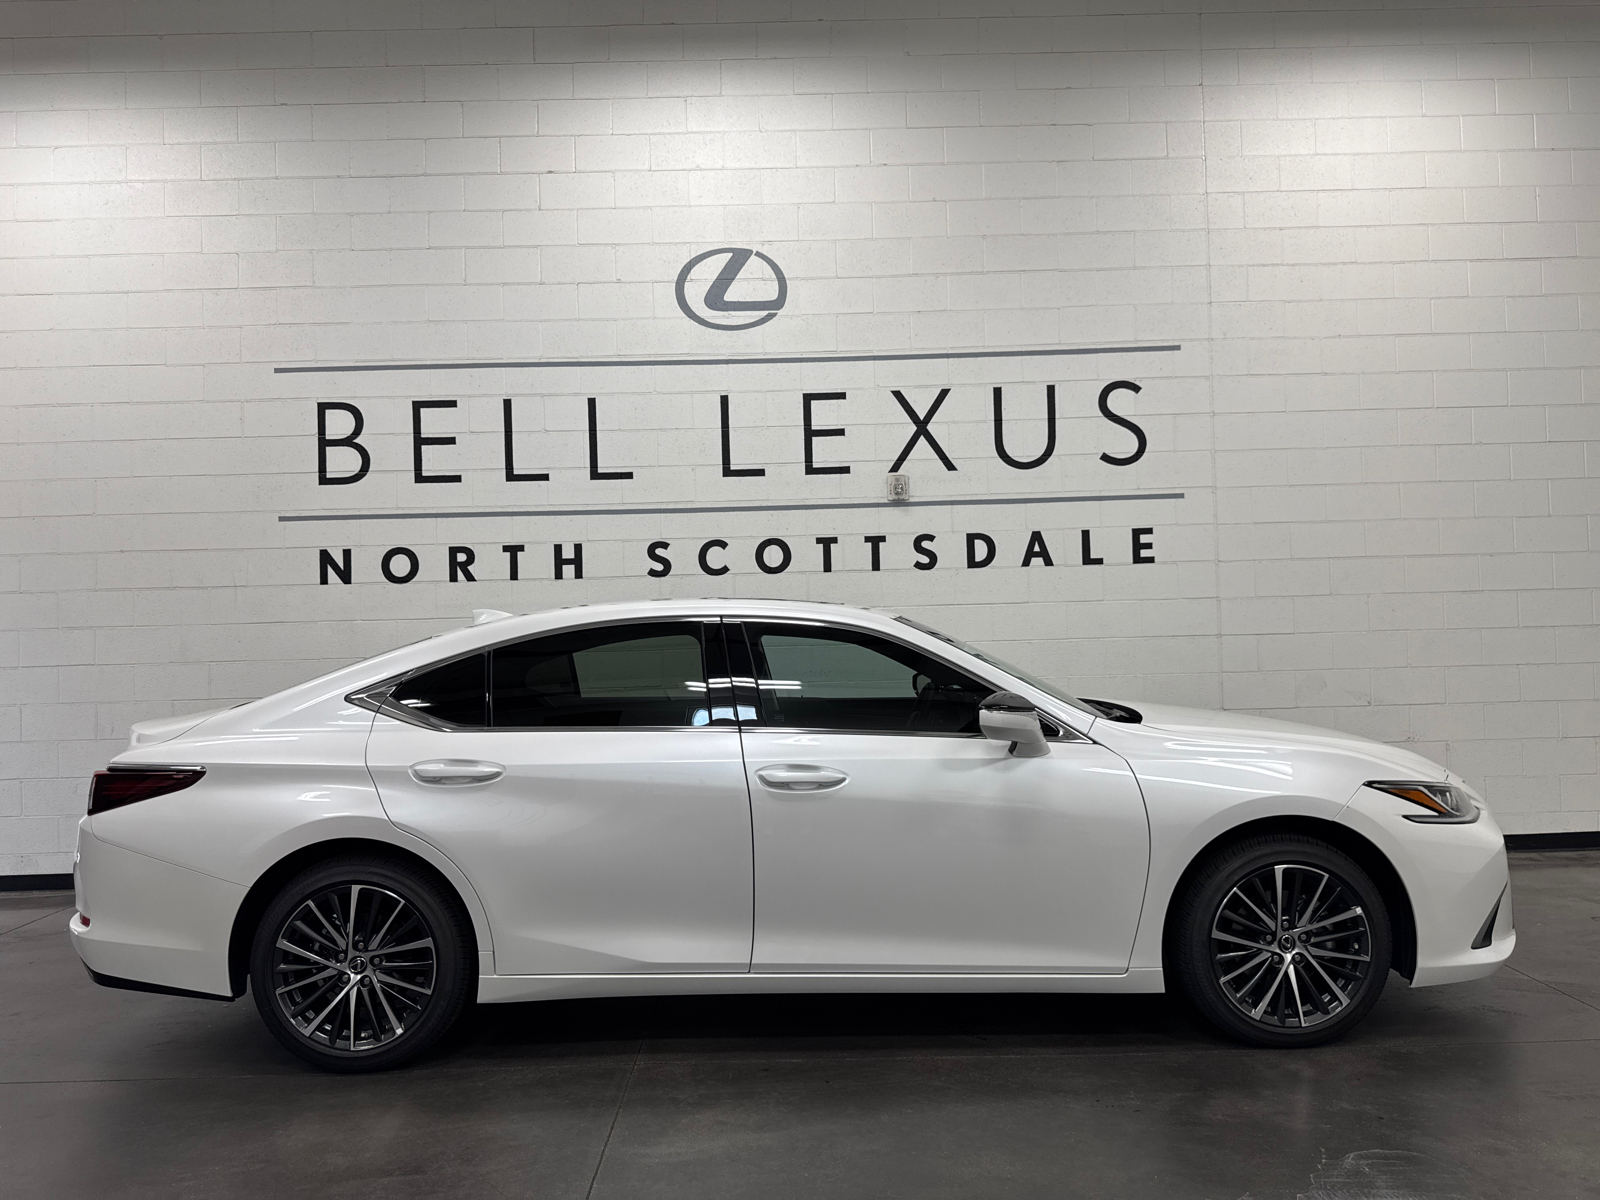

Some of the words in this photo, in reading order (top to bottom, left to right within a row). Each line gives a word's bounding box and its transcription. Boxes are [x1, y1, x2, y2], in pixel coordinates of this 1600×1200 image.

[317, 397, 634, 486] BELL
[719, 379, 1148, 478] LEXUS
[318, 542, 584, 586] NORTH
[646, 527, 1156, 579] SCOTTSDALE
